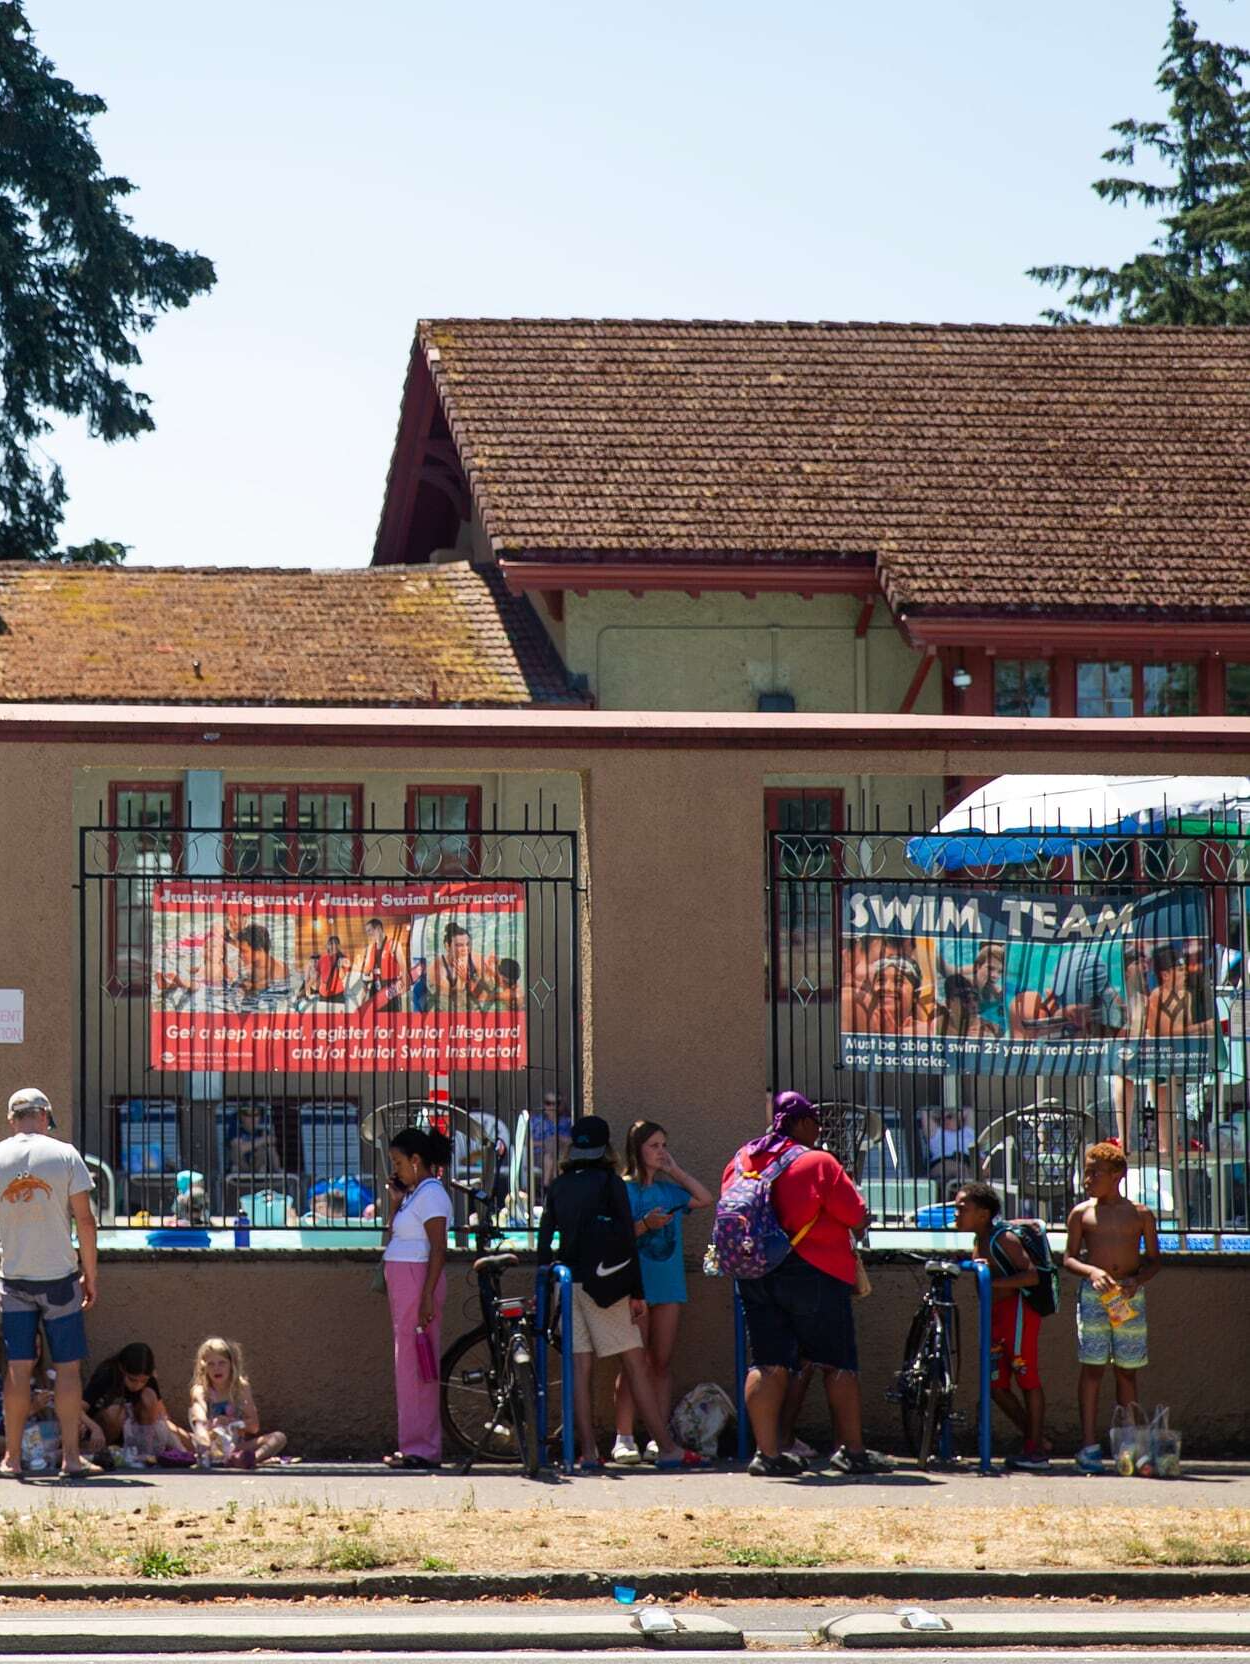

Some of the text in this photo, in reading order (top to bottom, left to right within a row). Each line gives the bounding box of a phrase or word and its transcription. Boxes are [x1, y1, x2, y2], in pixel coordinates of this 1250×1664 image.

[160, 888, 217, 904] Junior
[221, 890, 305, 908] Lifeguard
[320, 891, 376, 907] Junior
[381, 891, 429, 907] Swim
[433, 891, 517, 906] Instructor
[850, 892, 1135, 938] SWIM TEAM
[166, 1024, 521, 1043] Get a step ahead, register for Junior Lifeguard
[292, 1043, 522, 1061] and/or Junior Swim Instructor!
[845, 1037, 876, 1050] Must
[879, 1038, 896, 1051] be
[900, 1039, 928, 1052] able
[932, 1040, 944, 1052] to
[947, 1041, 981, 1054] swim
[984, 1042, 1000, 1054] 25
[1003, 1043, 1039, 1057] yards
[1042, 1044, 1071, 1055] front
[845, 1053, 950, 1068] and backstroke.
